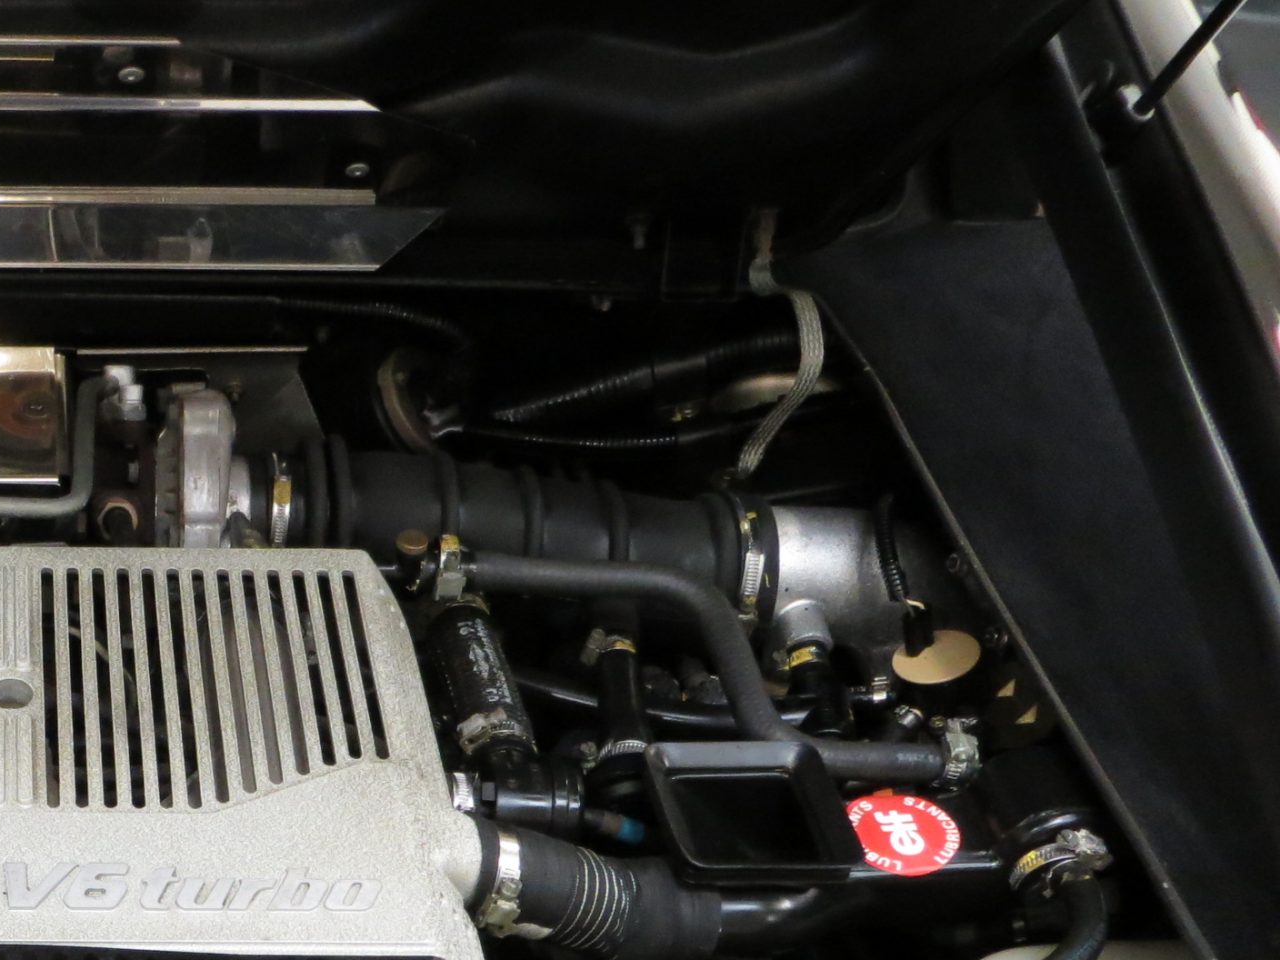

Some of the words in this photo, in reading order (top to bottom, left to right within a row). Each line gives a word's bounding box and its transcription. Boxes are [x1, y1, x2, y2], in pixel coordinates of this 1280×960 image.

[873, 810, 925, 855] elf
[903, 796, 960, 865] LUBRICANTS
[3, 861, 130, 911] V6
[139, 866, 383, 911] turbo
